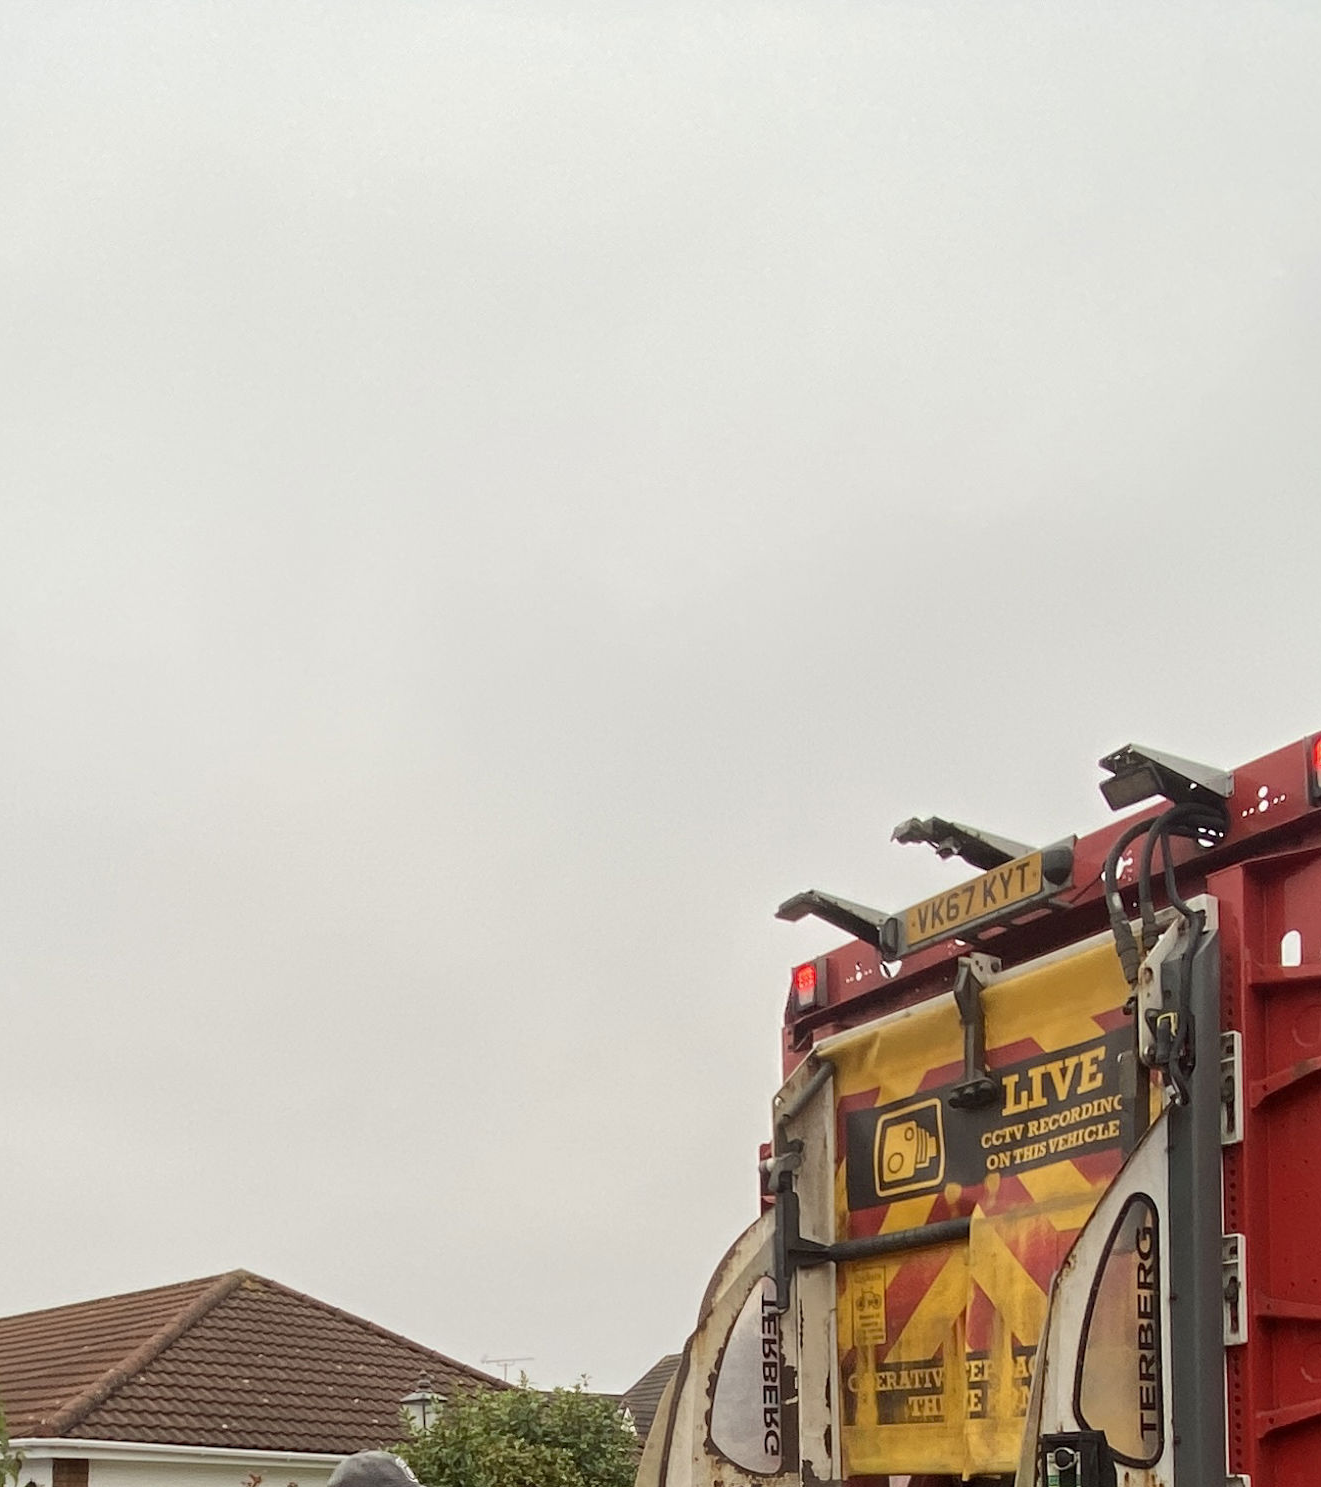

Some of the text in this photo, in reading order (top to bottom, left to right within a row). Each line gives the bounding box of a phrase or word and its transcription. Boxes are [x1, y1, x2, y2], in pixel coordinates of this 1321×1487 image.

[918, 861, 1031, 934] VK67 KYT
[1001, 1046, 1106, 1117] LIVE
[981, 1124, 1026, 1148] CCTV
[986, 1120, 1120, 1170] ON THIS VEHICLE
[1136, 1227, 1157, 1441] TERBERG
